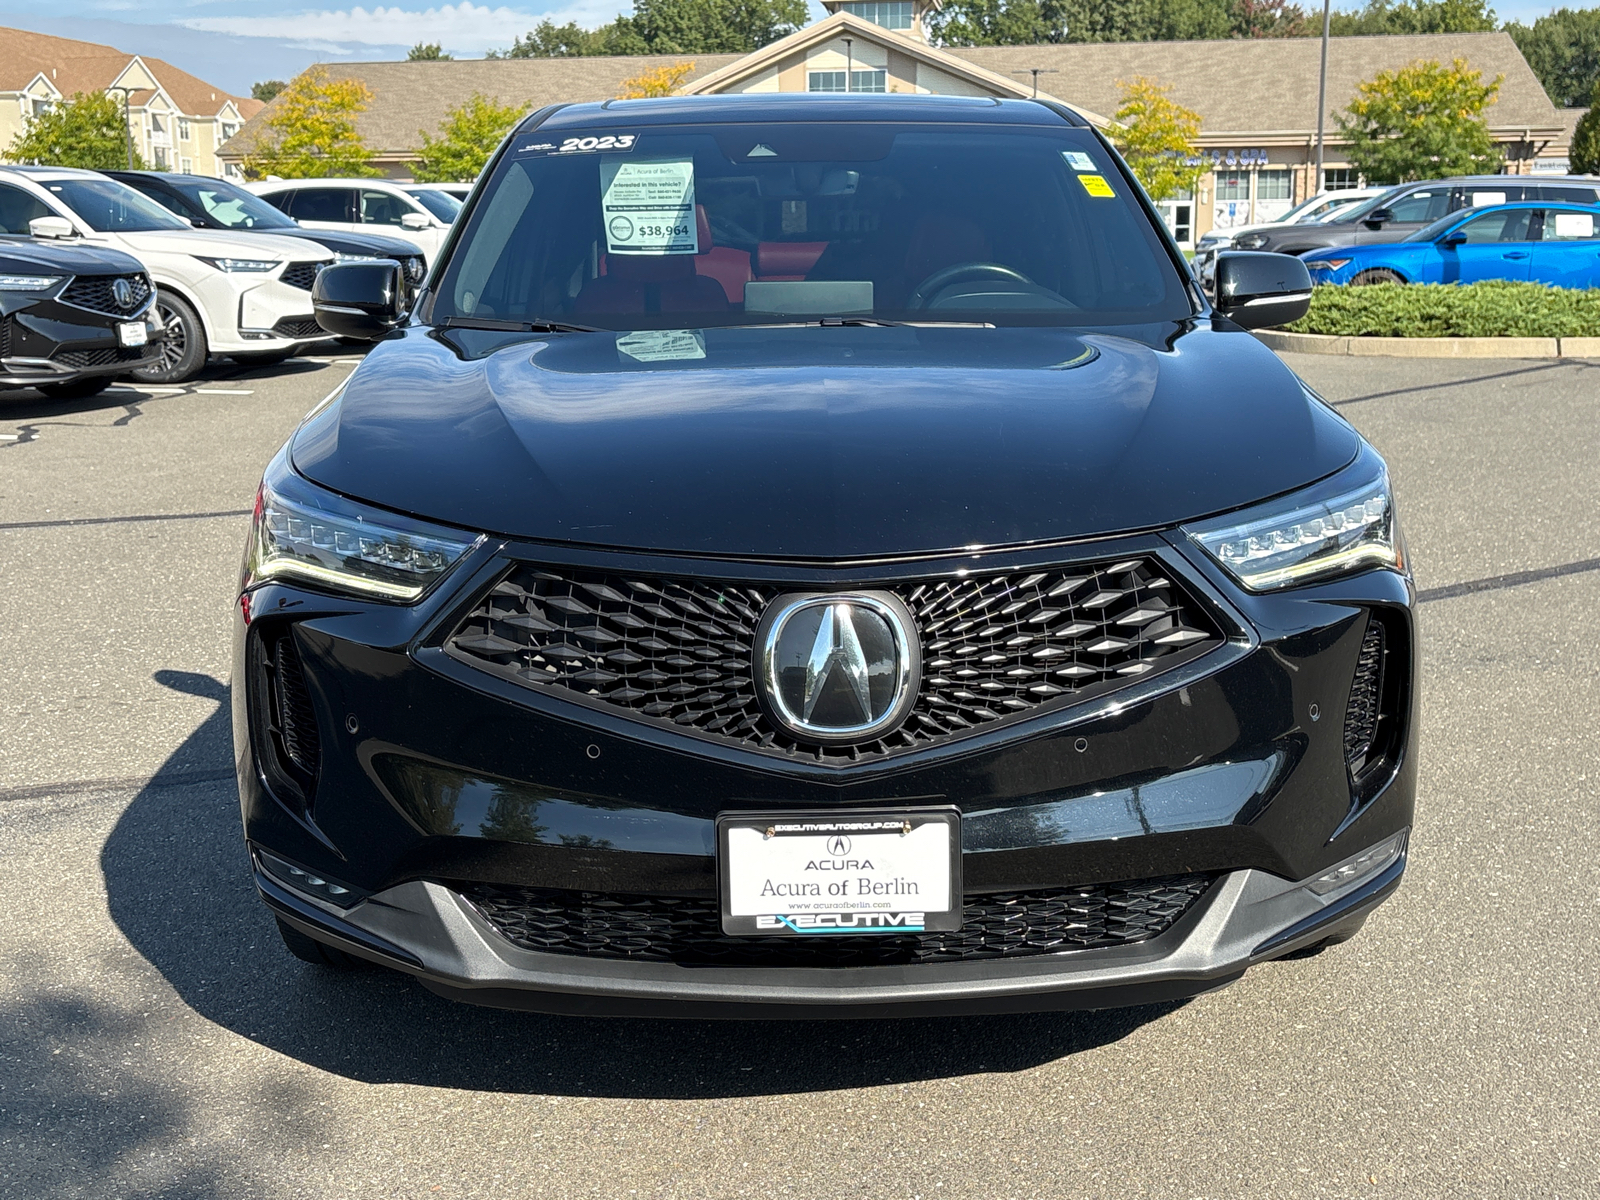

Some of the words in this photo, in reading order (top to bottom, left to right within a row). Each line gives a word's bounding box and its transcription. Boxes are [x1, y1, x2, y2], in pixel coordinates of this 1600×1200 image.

[560, 136, 635, 151] 2023
[1226, 150, 1237, 166] &
[1240, 149, 1268, 166] SPA
[639, 225, 689, 238] $38,964
[775, 822, 904, 831] EXECUTIVEAUTOGROUP.COM
[804, 860, 875, 871] ACURA
[760, 878, 821, 896] Acura
[828, 880, 849, 896] of
[857, 877, 919, 895] Berlin
[788, 901, 891, 909] www.acuraofberlin.com
[756, 912, 925, 930] EXECUTIVE
